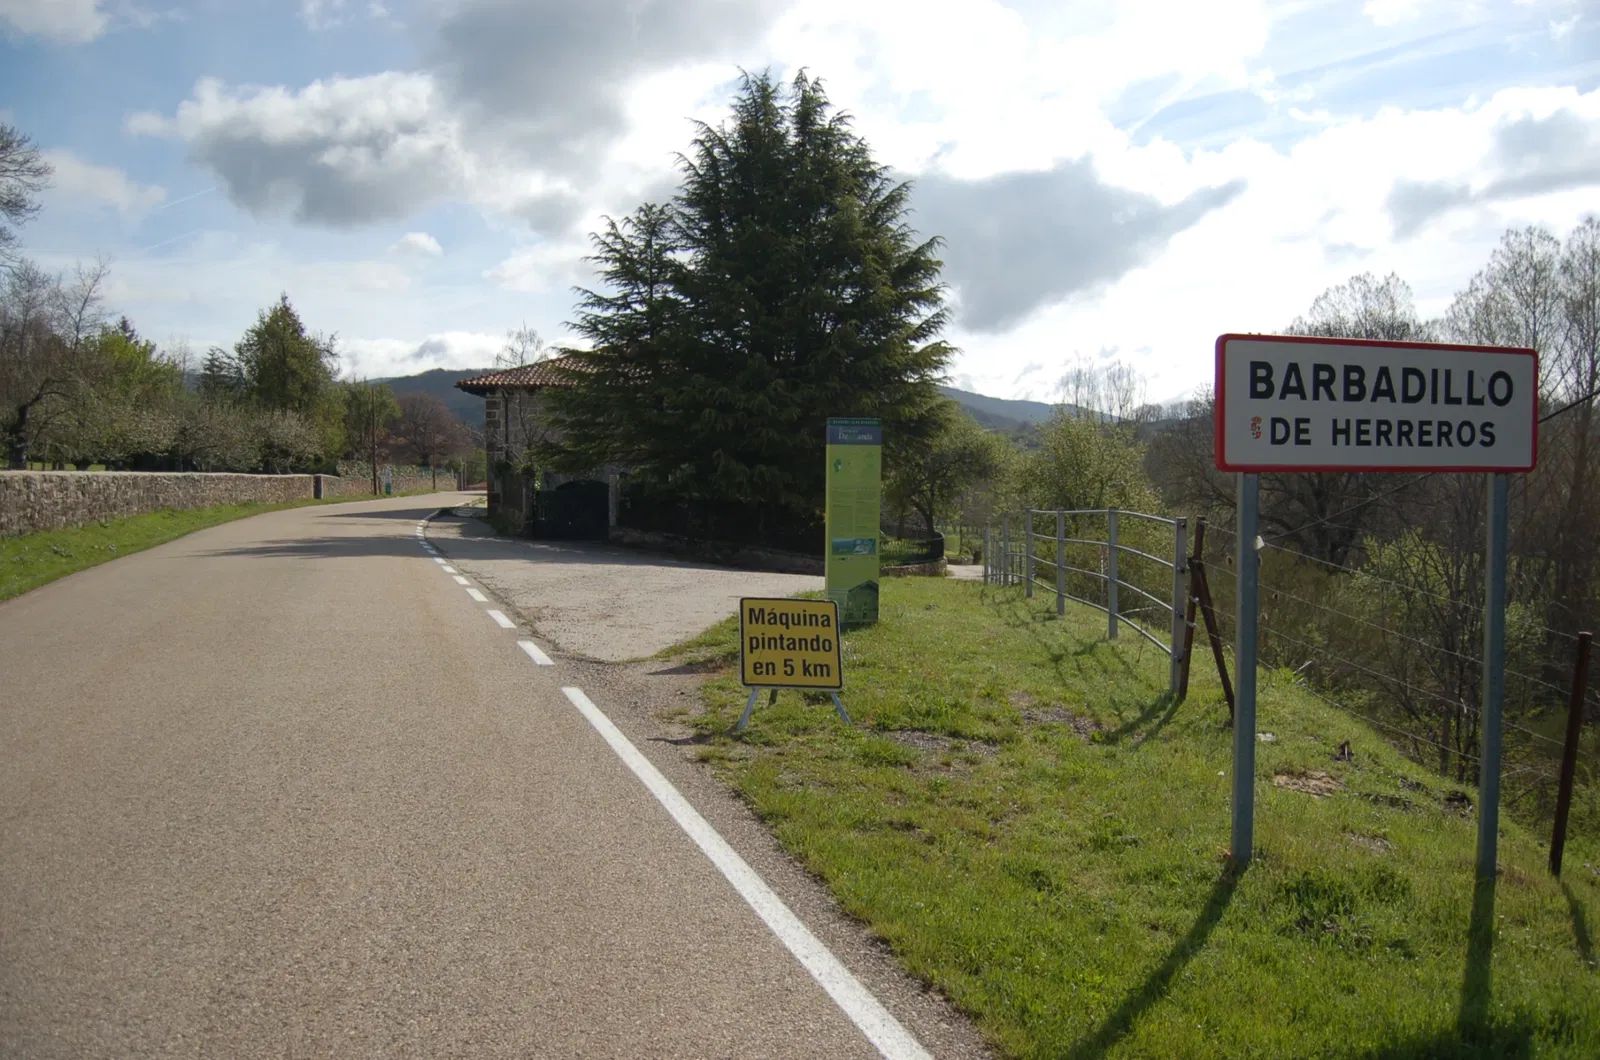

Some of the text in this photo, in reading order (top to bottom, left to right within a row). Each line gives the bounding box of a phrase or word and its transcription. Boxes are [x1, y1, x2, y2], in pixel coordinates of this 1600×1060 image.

[1249, 361, 1514, 407] BARBADILLO
[837, 431, 873, 440] Deanda
[1270, 417, 1496, 448] DE HERREROS
[748, 607, 831, 629] Máquina
[749, 633, 832, 654] pintando
[753, 658, 831, 678] en 5 km
